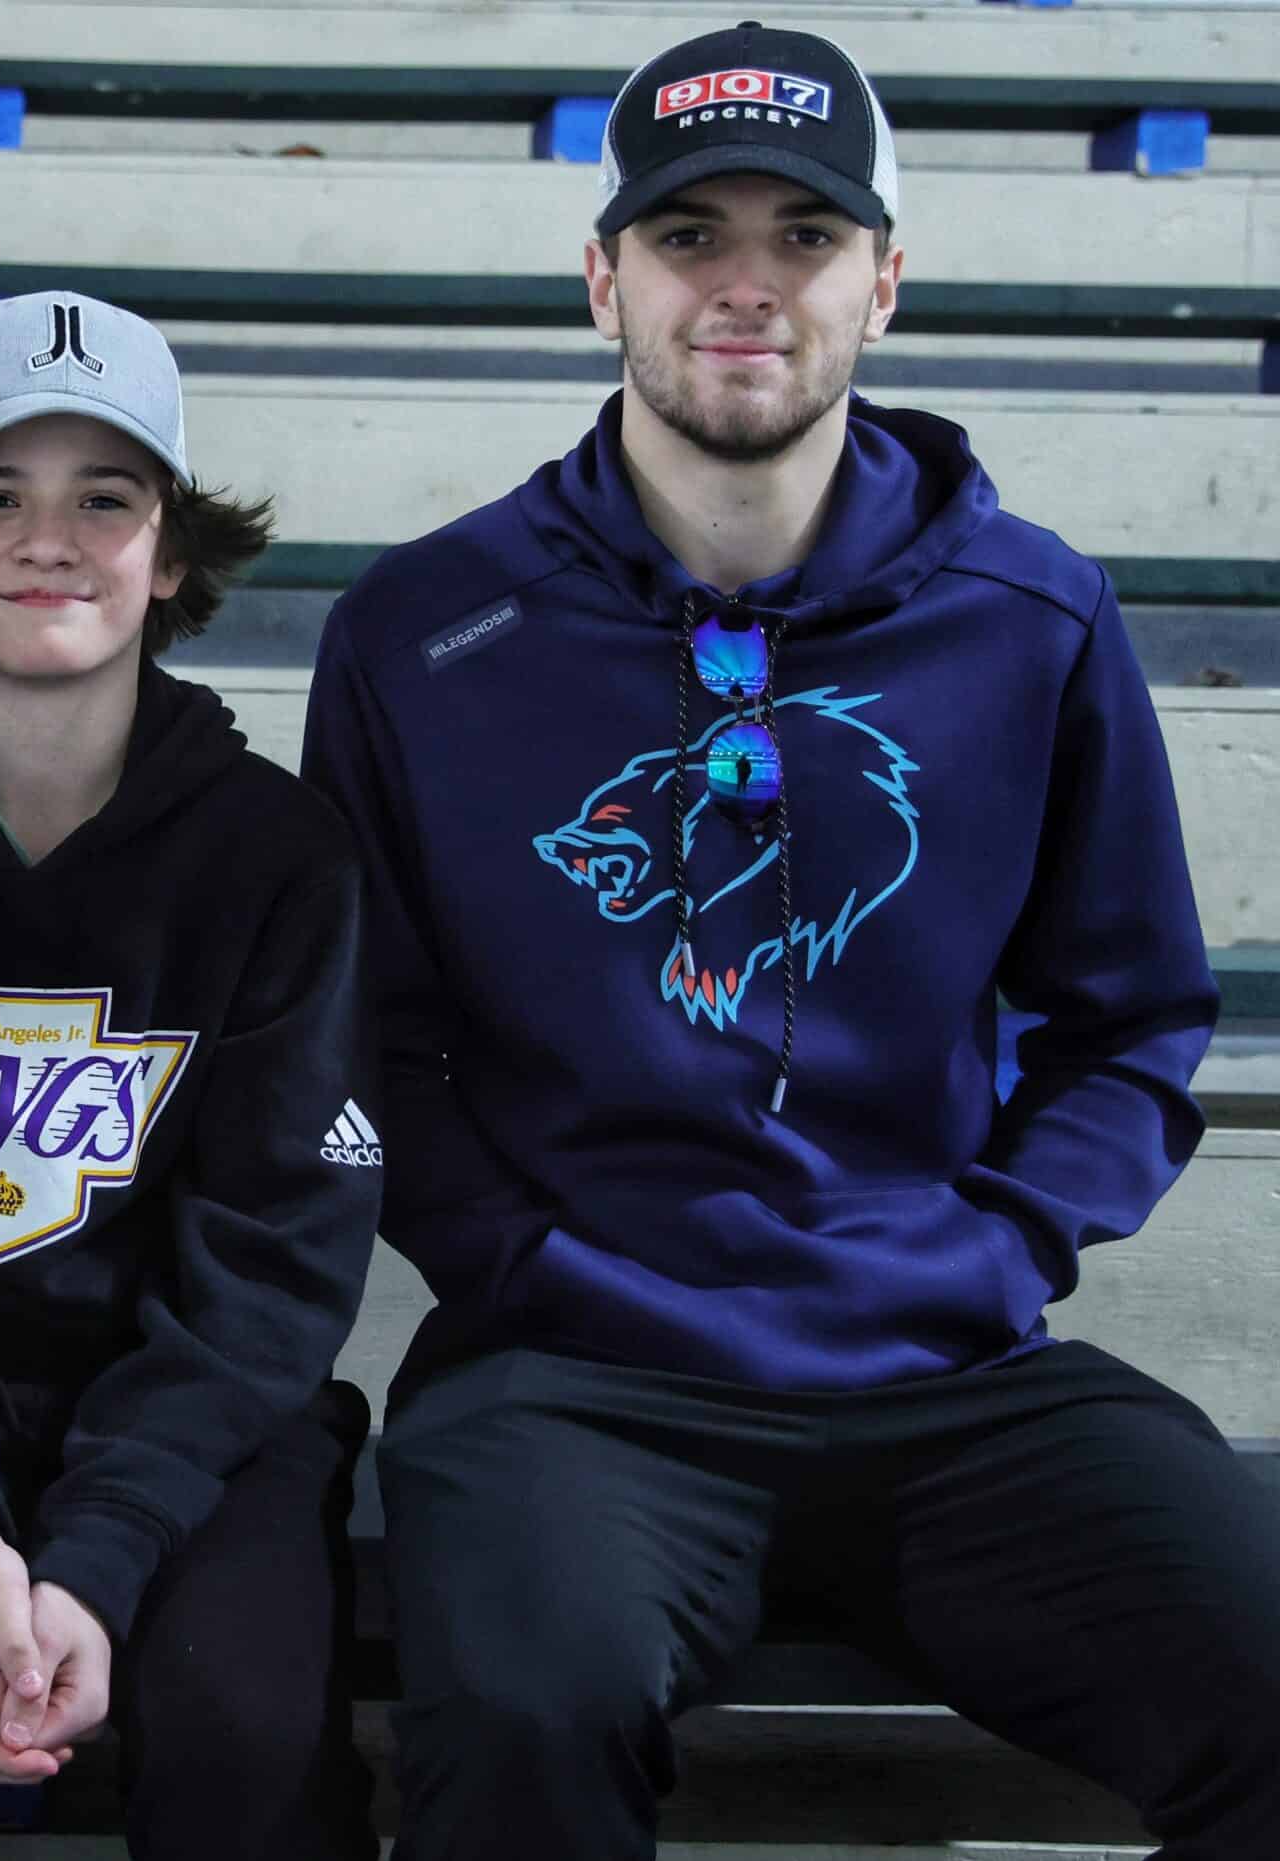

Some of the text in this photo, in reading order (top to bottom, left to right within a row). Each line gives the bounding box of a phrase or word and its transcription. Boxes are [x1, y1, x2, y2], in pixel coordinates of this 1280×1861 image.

[667, 74, 818, 107] 907
[679, 107, 801, 128] HOCKEY
[67, 1024, 86, 1041] Jr.
[320, 1143, 383, 1167] adida
